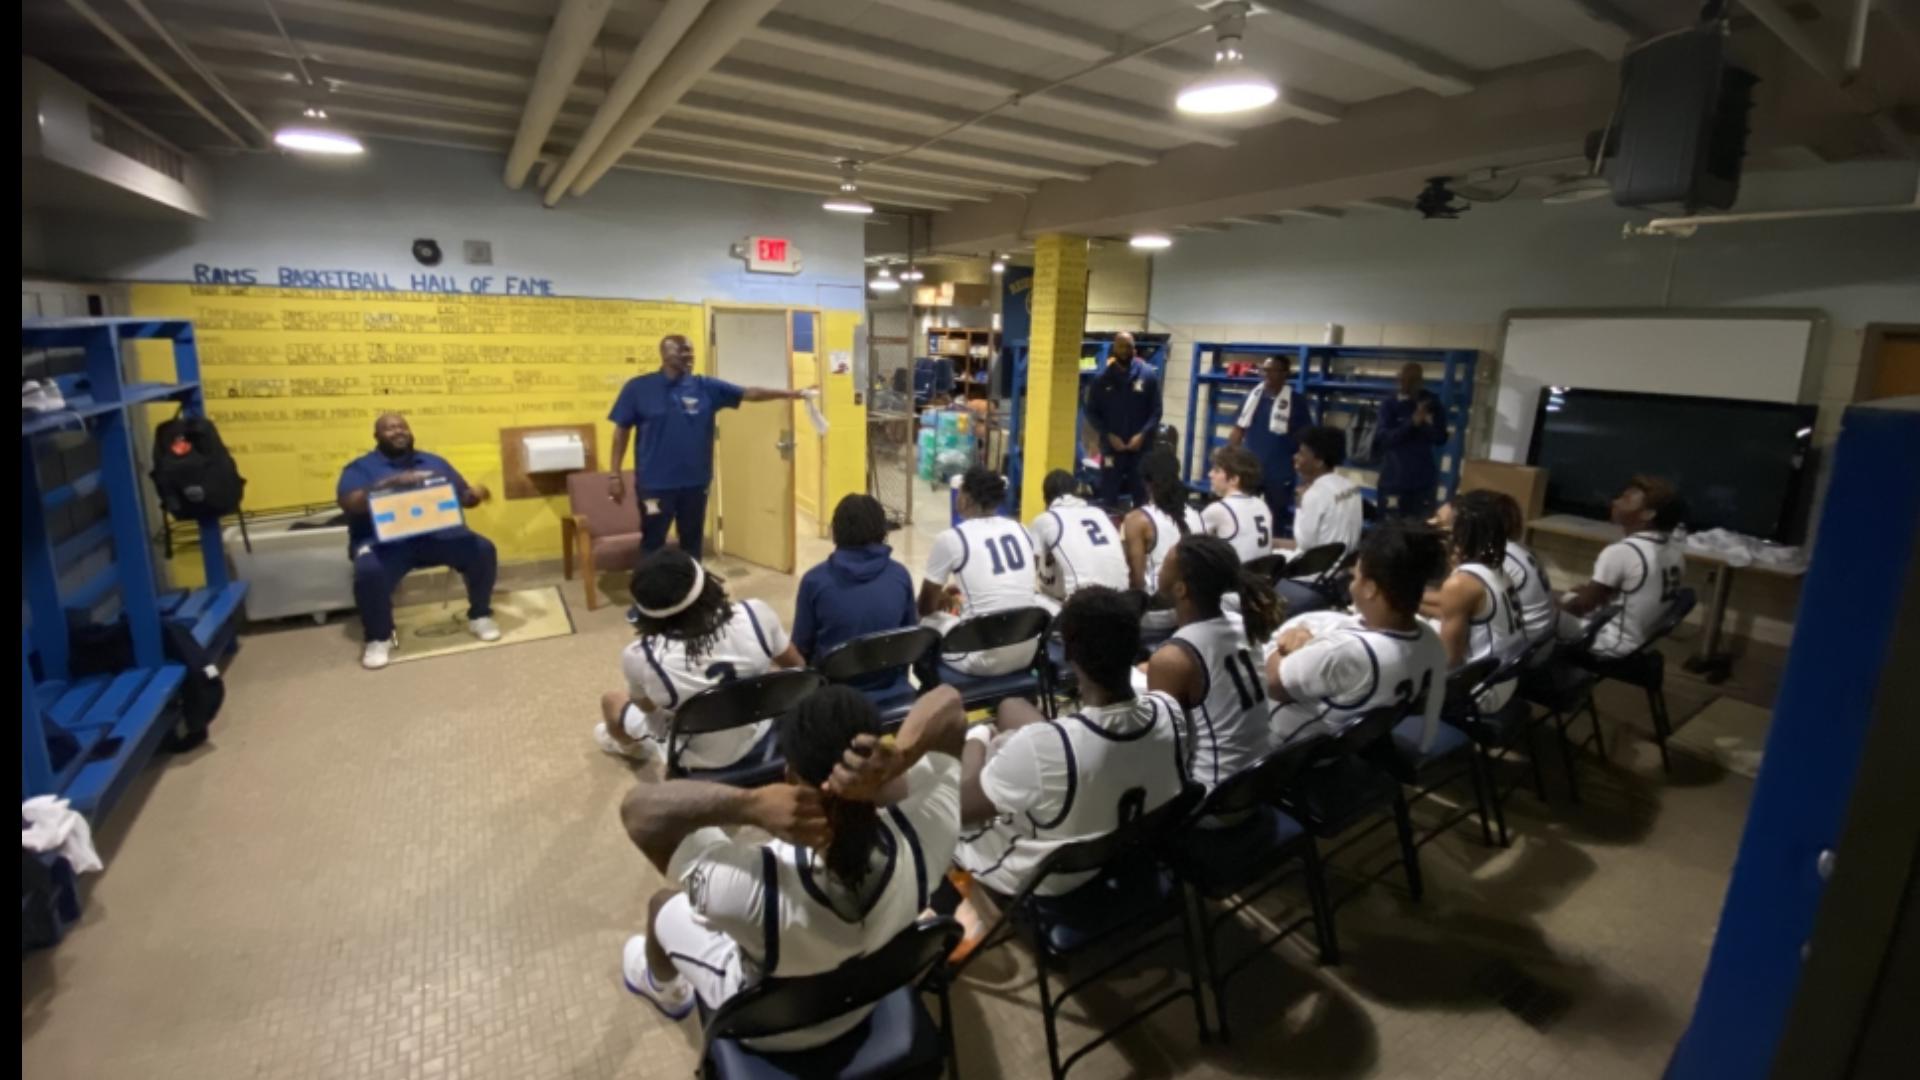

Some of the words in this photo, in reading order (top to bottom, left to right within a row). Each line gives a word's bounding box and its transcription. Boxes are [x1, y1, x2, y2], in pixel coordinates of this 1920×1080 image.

[759, 239, 786, 261] EXIT
[194, 261, 258, 286] RAMS
[278, 266, 398, 291] BASKETBALL
[411, 272, 461, 293] HALL
[470, 276, 494, 293] OF
[506, 276, 554, 296] FAME
[1081, 519, 1109, 546] 2
[1254, 516, 1269, 548] 5
[985, 534, 1025, 575] 10
[1224, 648, 1264, 711] 11
